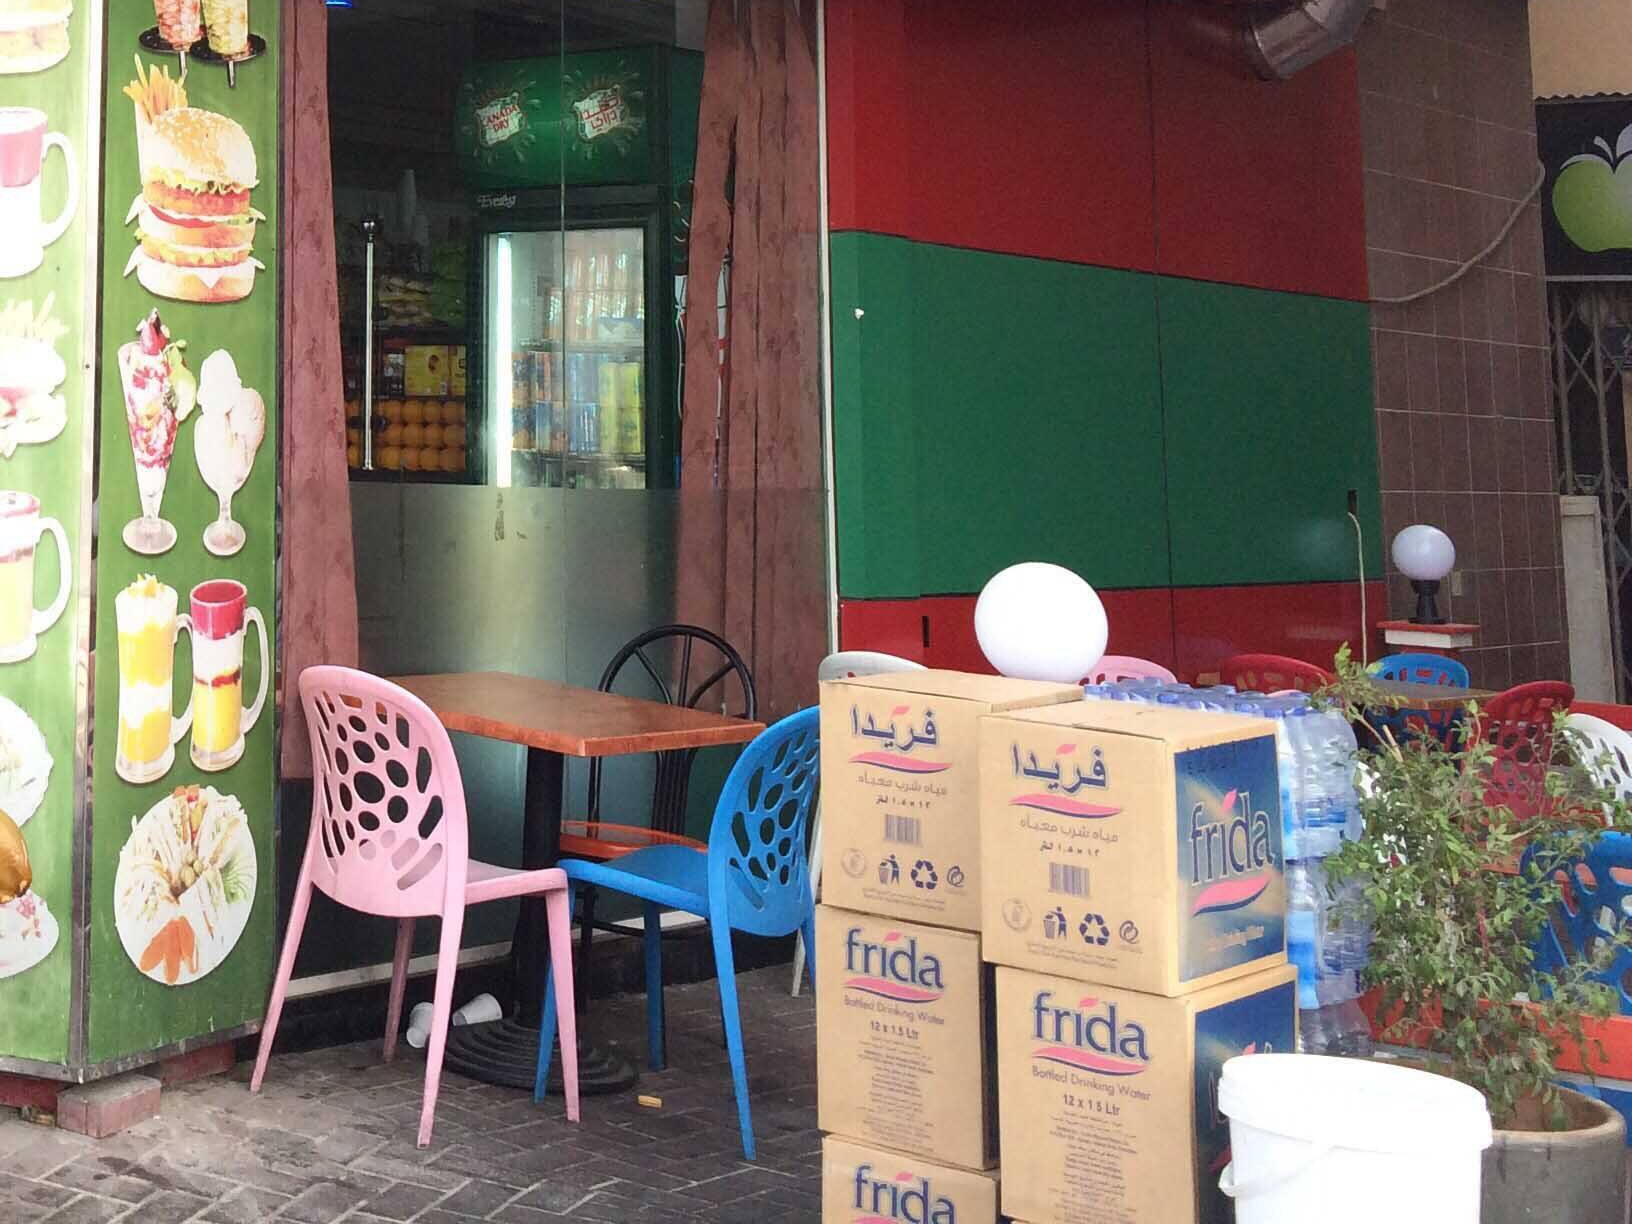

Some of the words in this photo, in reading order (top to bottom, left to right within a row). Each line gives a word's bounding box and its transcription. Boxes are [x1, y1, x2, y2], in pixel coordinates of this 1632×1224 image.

[1190, 791, 1274, 886] frida
[845, 927, 945, 989] frida
[870, 1020, 881, 1031] 12
[1032, 991, 1151, 1061] frida
[1032, 1065, 1068, 1084] Bottled
[1070, 1072, 1115, 1096] Drinking
[1117, 1084, 1152, 1102] Water
[1064, 1094, 1075, 1107] 12
[1105, 1101, 1121, 1117] Ltr
[853, 1164, 957, 1224] frida
